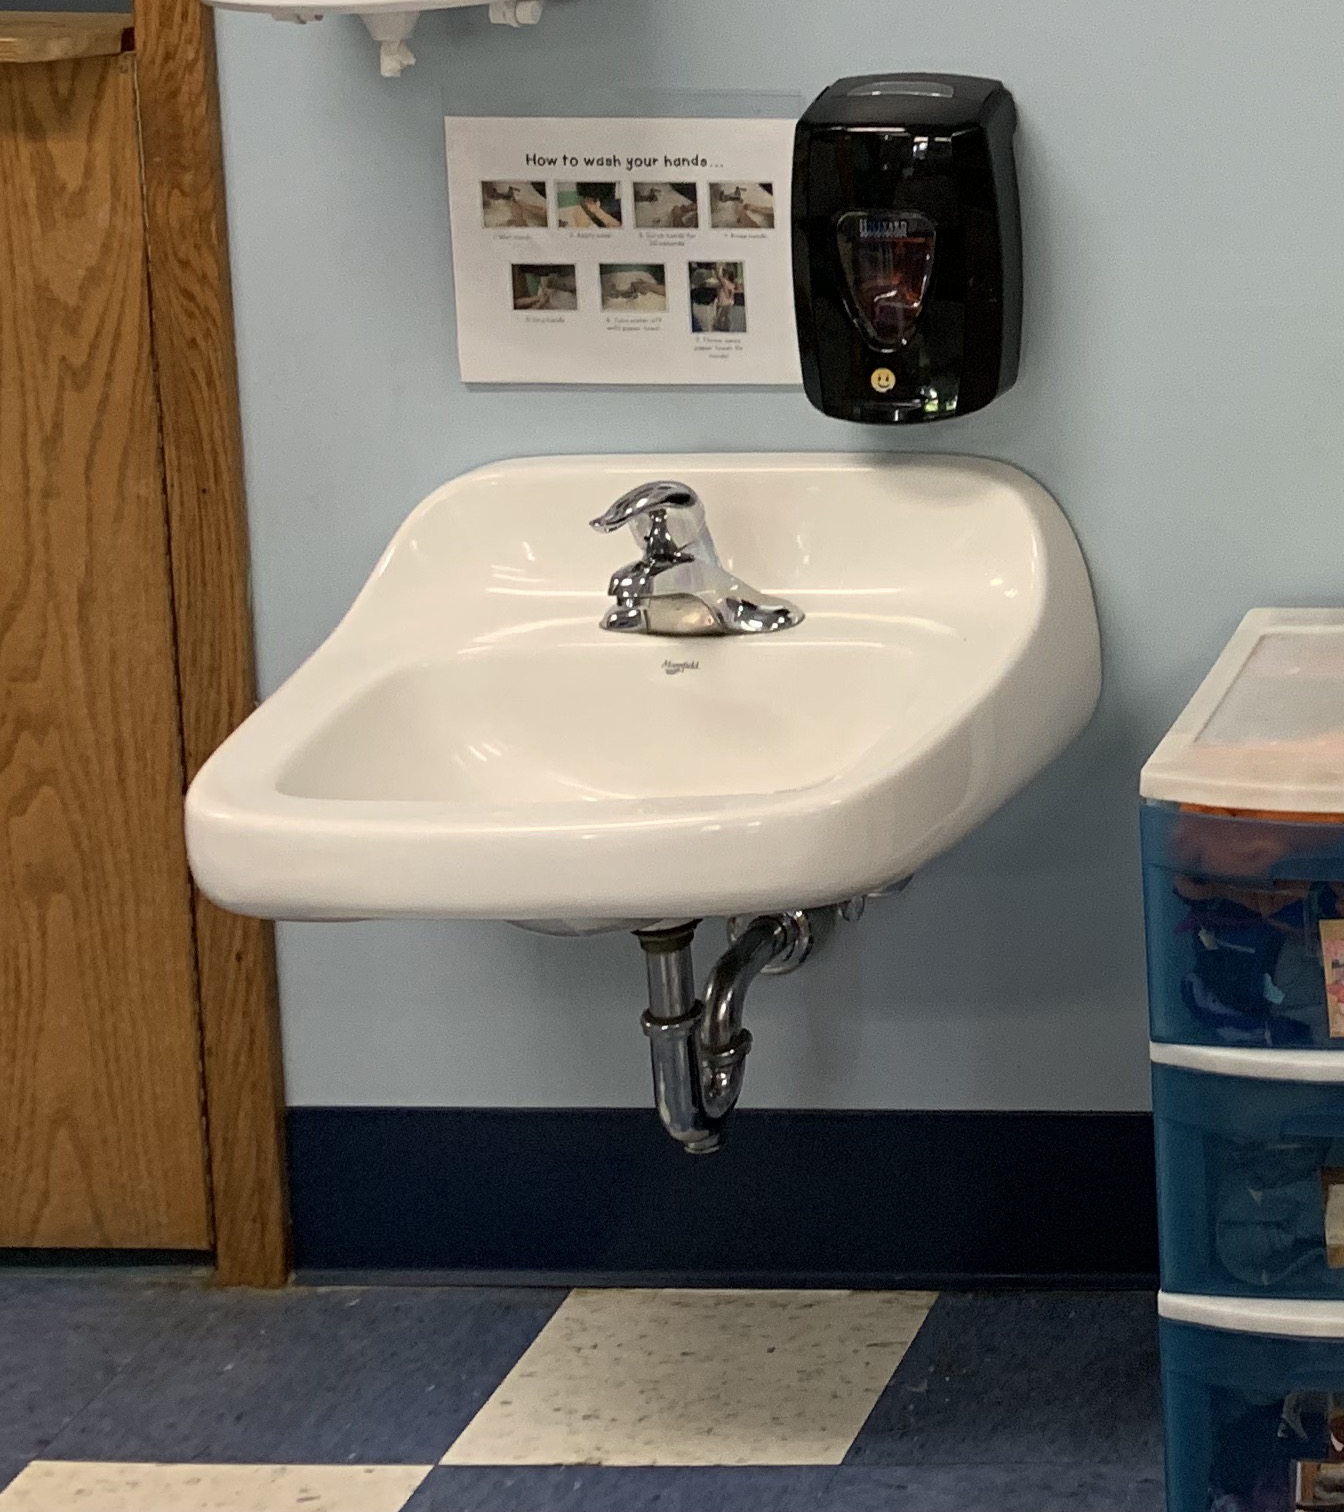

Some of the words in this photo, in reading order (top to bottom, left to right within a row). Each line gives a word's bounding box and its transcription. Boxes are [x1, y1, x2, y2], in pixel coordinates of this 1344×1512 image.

[525, 153, 557, 167] How
[562, 154, 578, 167] to
[584, 153, 621, 167] wash
[626, 156, 658, 171] your
